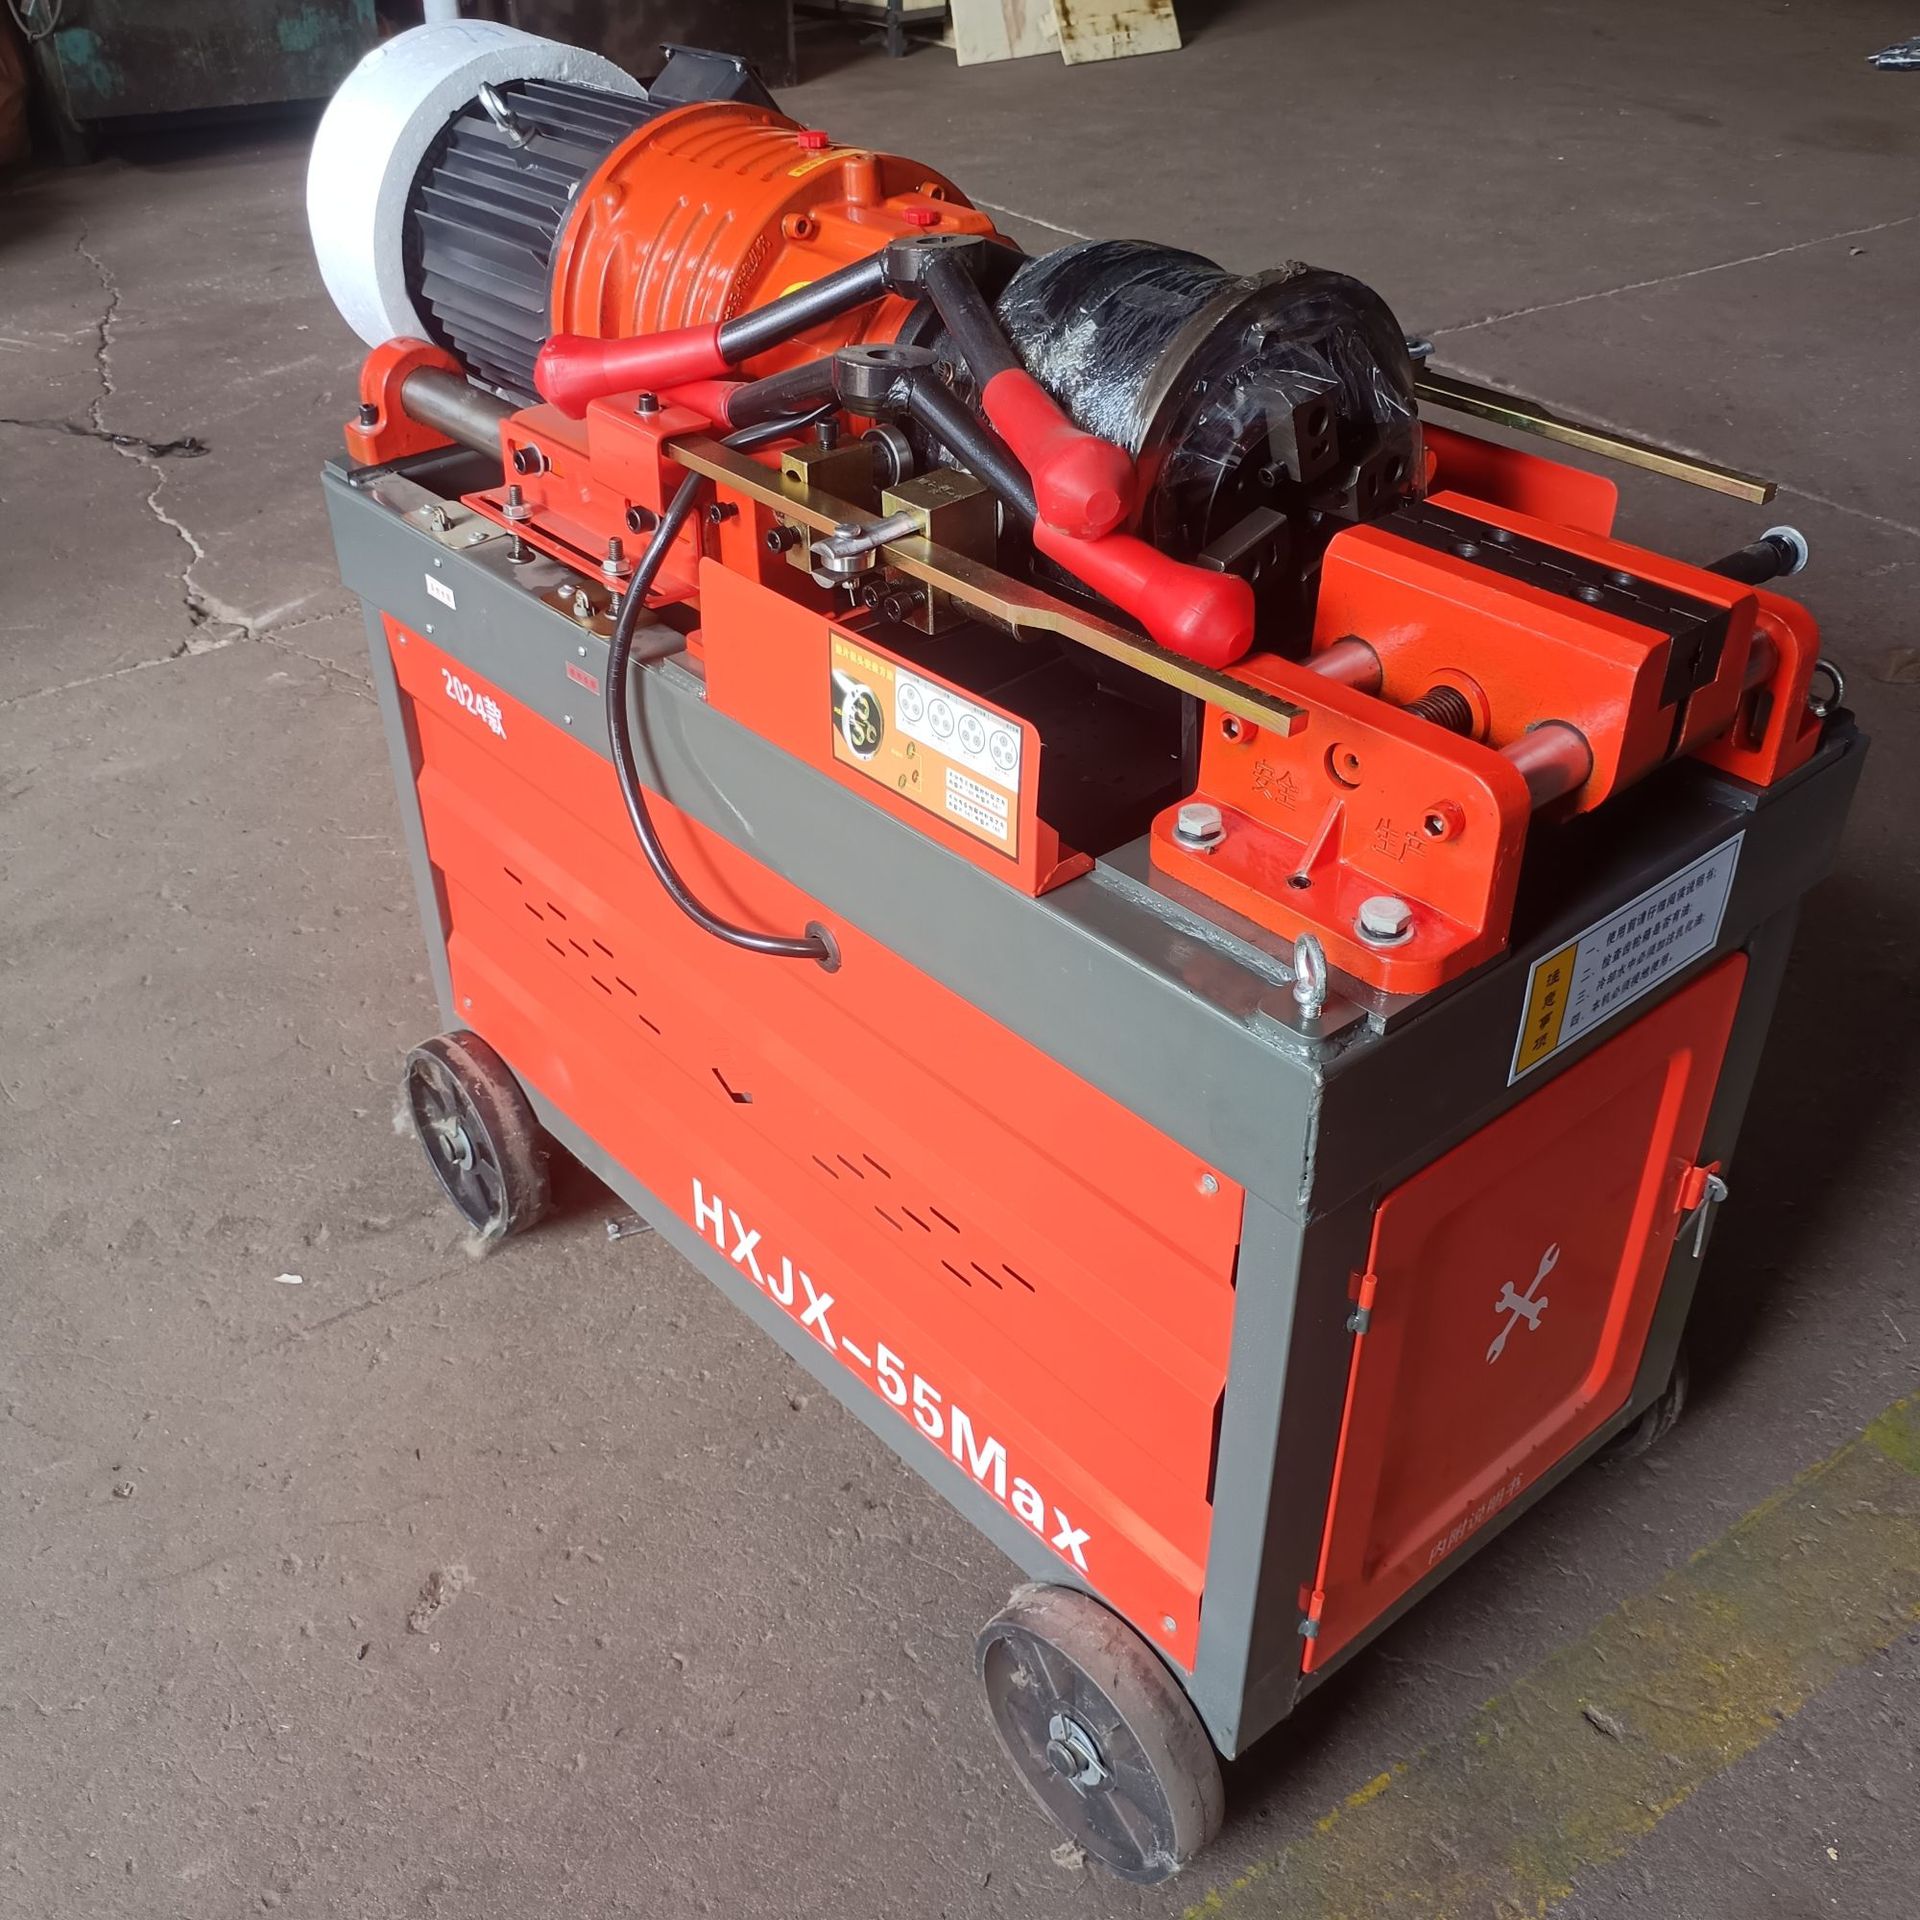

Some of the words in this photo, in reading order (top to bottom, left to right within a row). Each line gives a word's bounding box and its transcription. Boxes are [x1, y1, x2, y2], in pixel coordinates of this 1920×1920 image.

[1252, 759, 1299, 811] 安全
[1373, 818, 1426, 864] 生产
[691, 1177, 1092, 1572] HXJX-55Max
